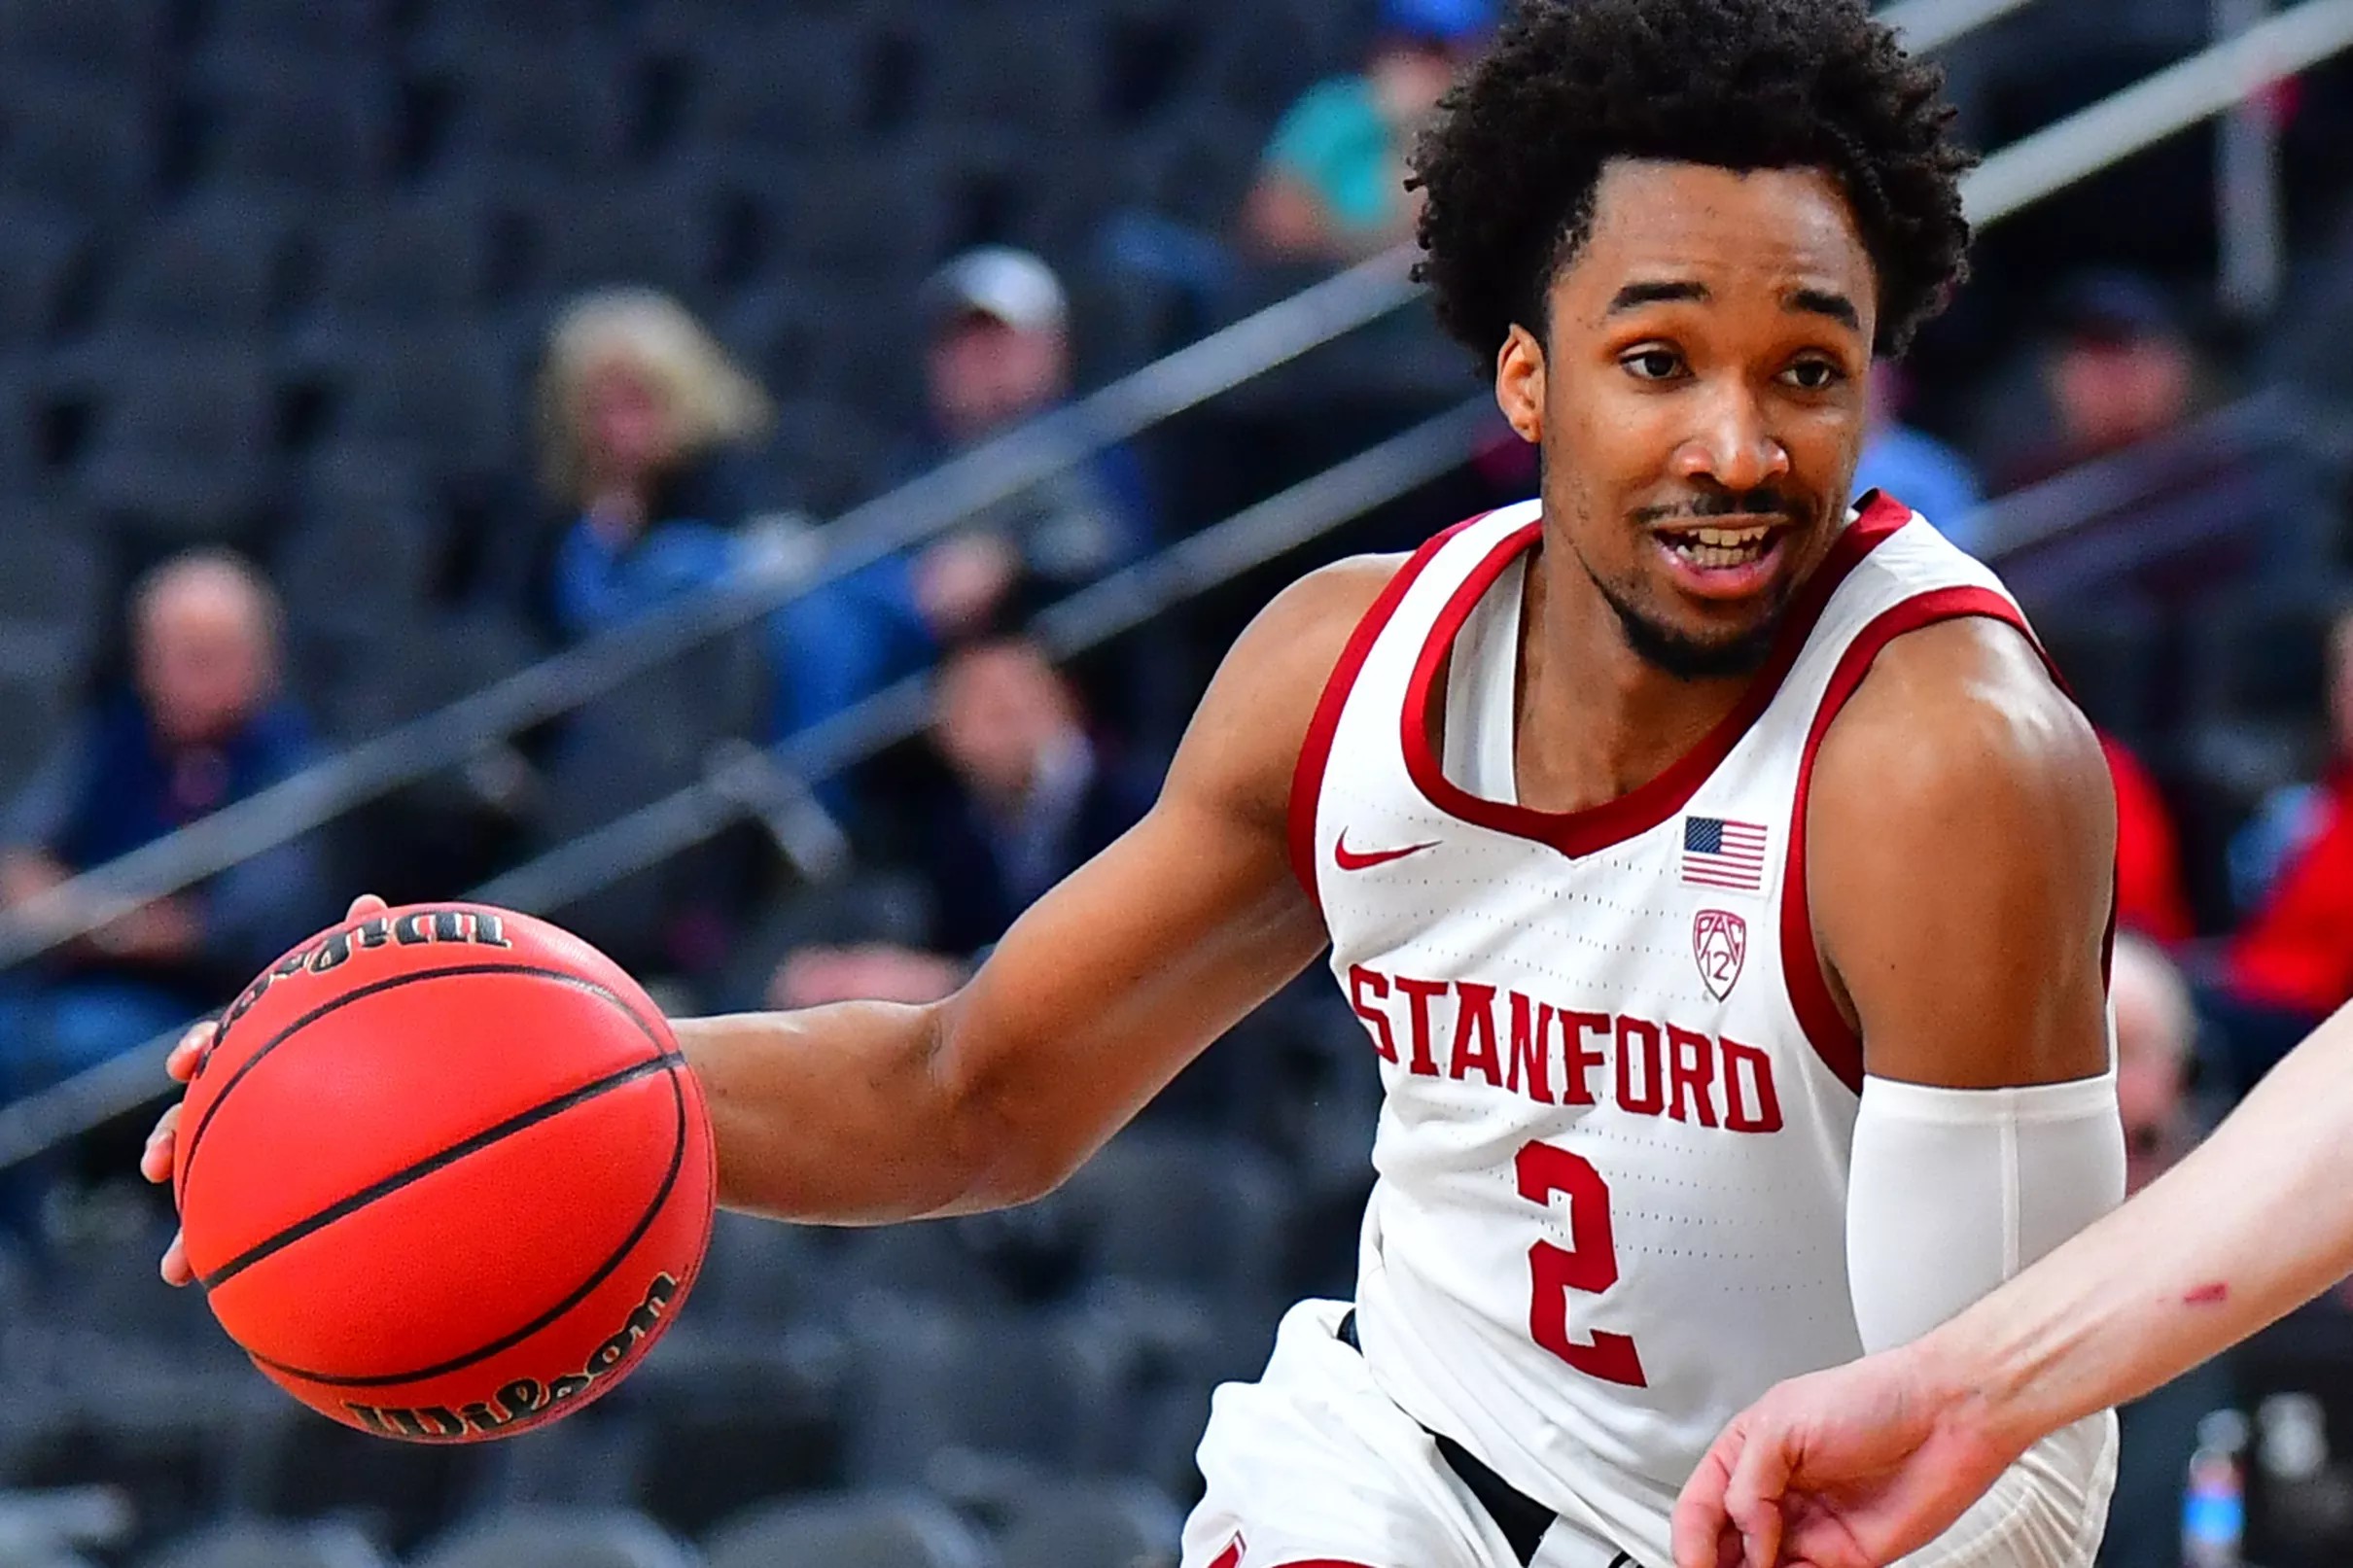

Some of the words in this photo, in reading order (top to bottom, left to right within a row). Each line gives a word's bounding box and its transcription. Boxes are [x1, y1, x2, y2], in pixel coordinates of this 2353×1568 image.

[1697, 915, 1742, 966] PAC
[1706, 950, 1730, 981] 12
[1349, 963, 1783, 1133] STANFORD
[1515, 1139, 1647, 1388] 2
[340, 1272, 677, 1438] Wilson
